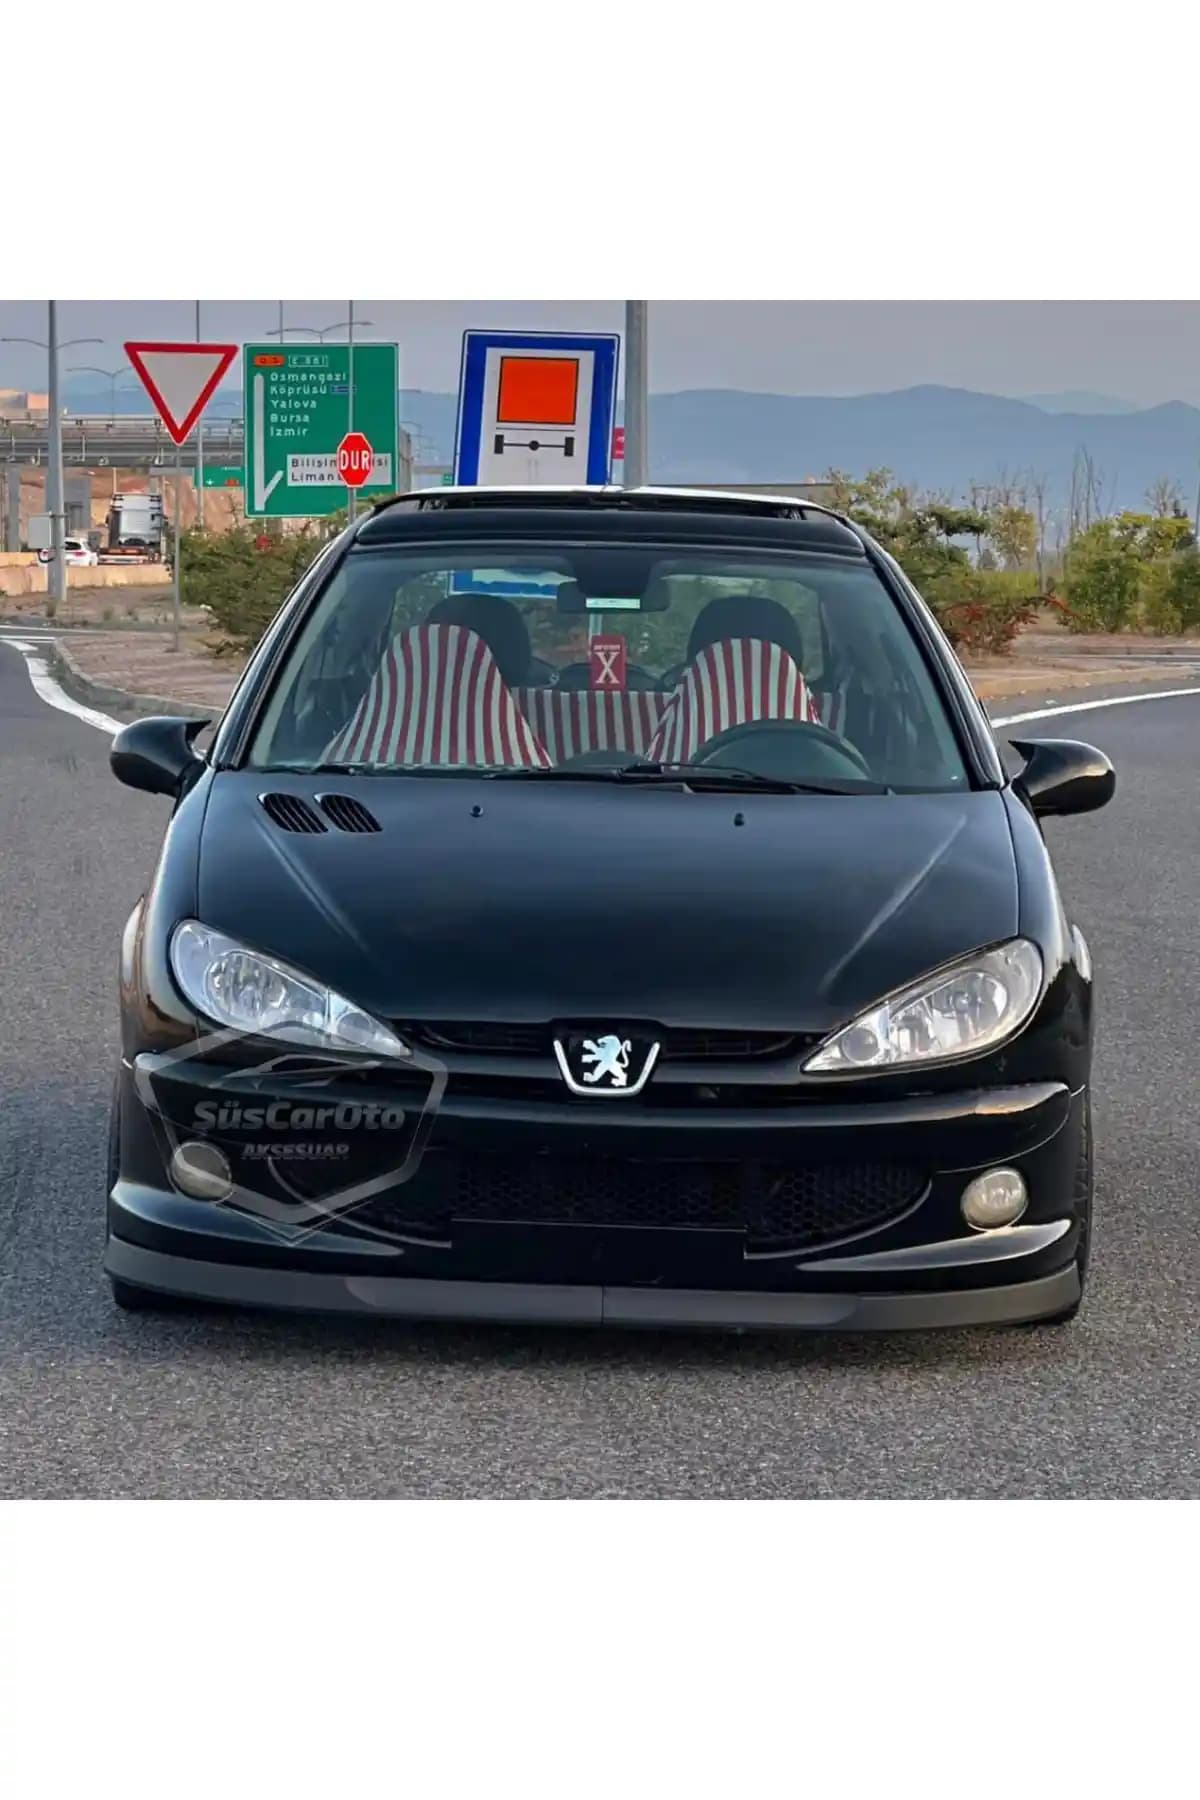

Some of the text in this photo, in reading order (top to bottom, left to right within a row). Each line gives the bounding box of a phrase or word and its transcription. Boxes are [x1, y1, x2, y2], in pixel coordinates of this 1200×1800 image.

[270, 372, 347, 385] Osmangazi
[270, 385, 328, 397] Köprüsü
[270, 399, 318, 409] Yalova
[270, 413, 311, 423] Bursa
[340, 450, 371, 471] DUR
